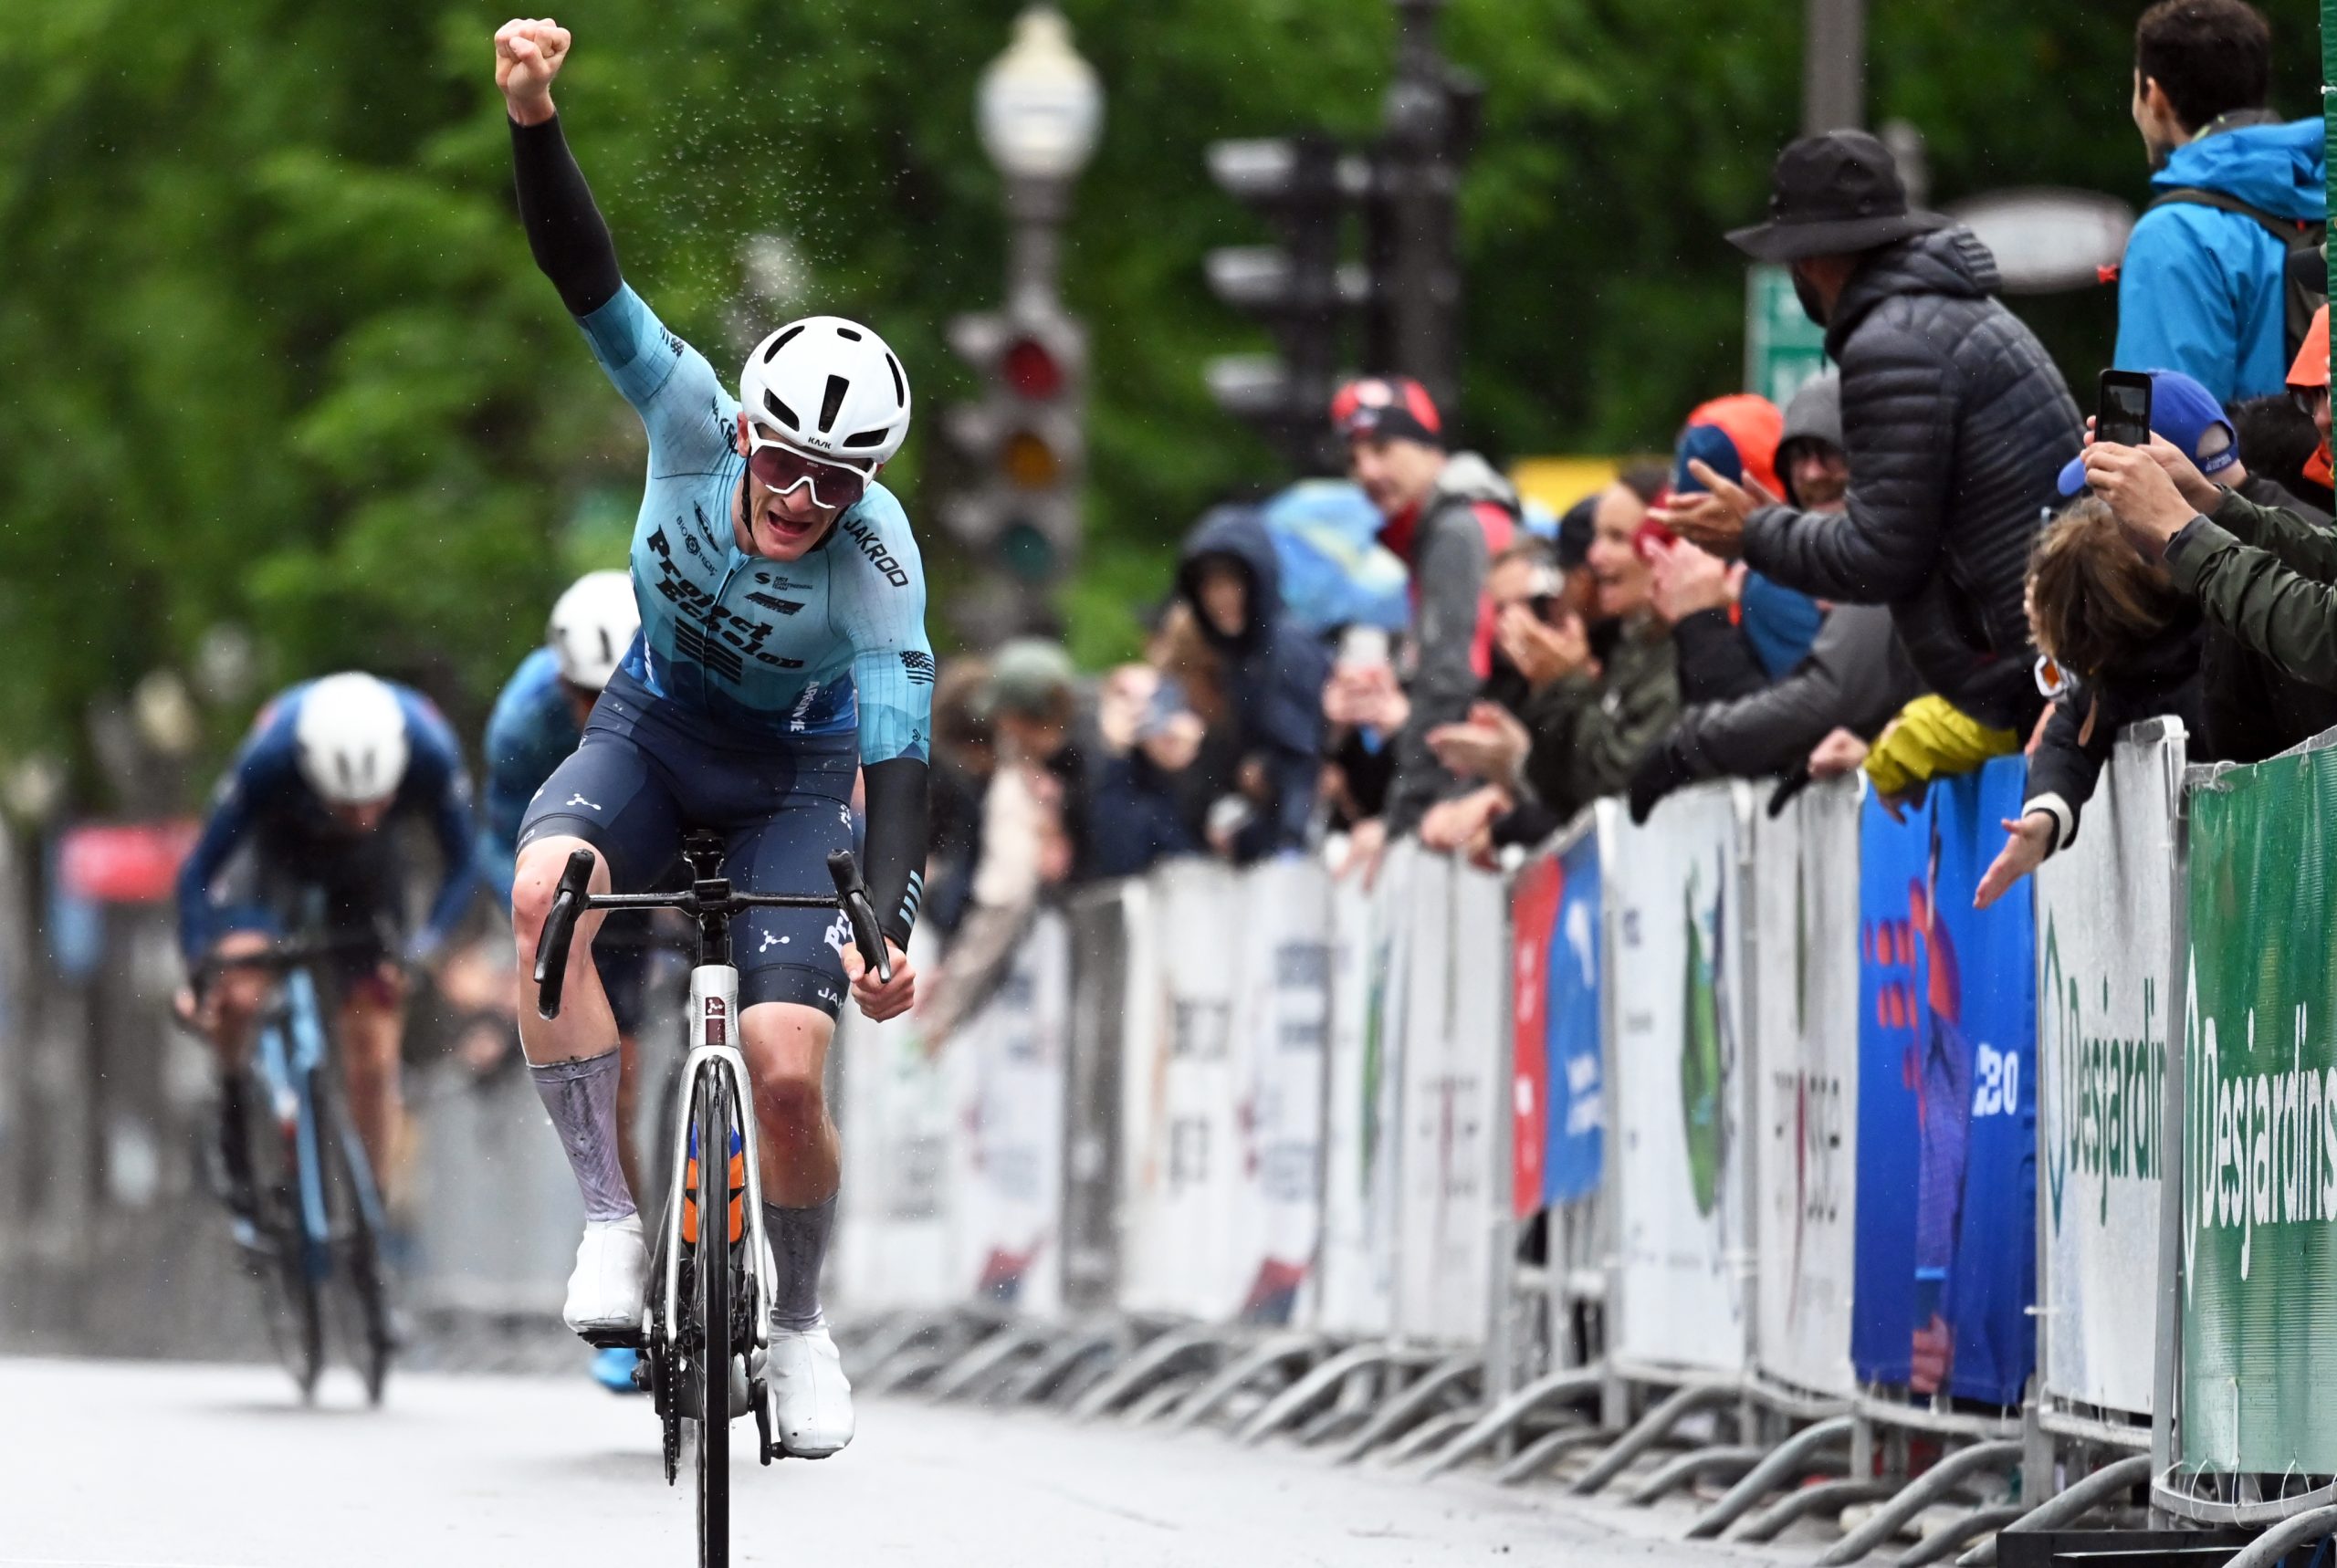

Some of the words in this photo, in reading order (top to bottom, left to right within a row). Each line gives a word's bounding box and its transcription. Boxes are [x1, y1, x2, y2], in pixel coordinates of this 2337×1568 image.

[807, 436, 832, 450] KASK
[646, 523, 774, 642] Project
[844, 517, 909, 588] JAKROO
[655, 573, 805, 669] Echelon
[2069, 975, 2167, 1228] Desjardin
[2202, 1000, 2337, 1281] Desjardins
